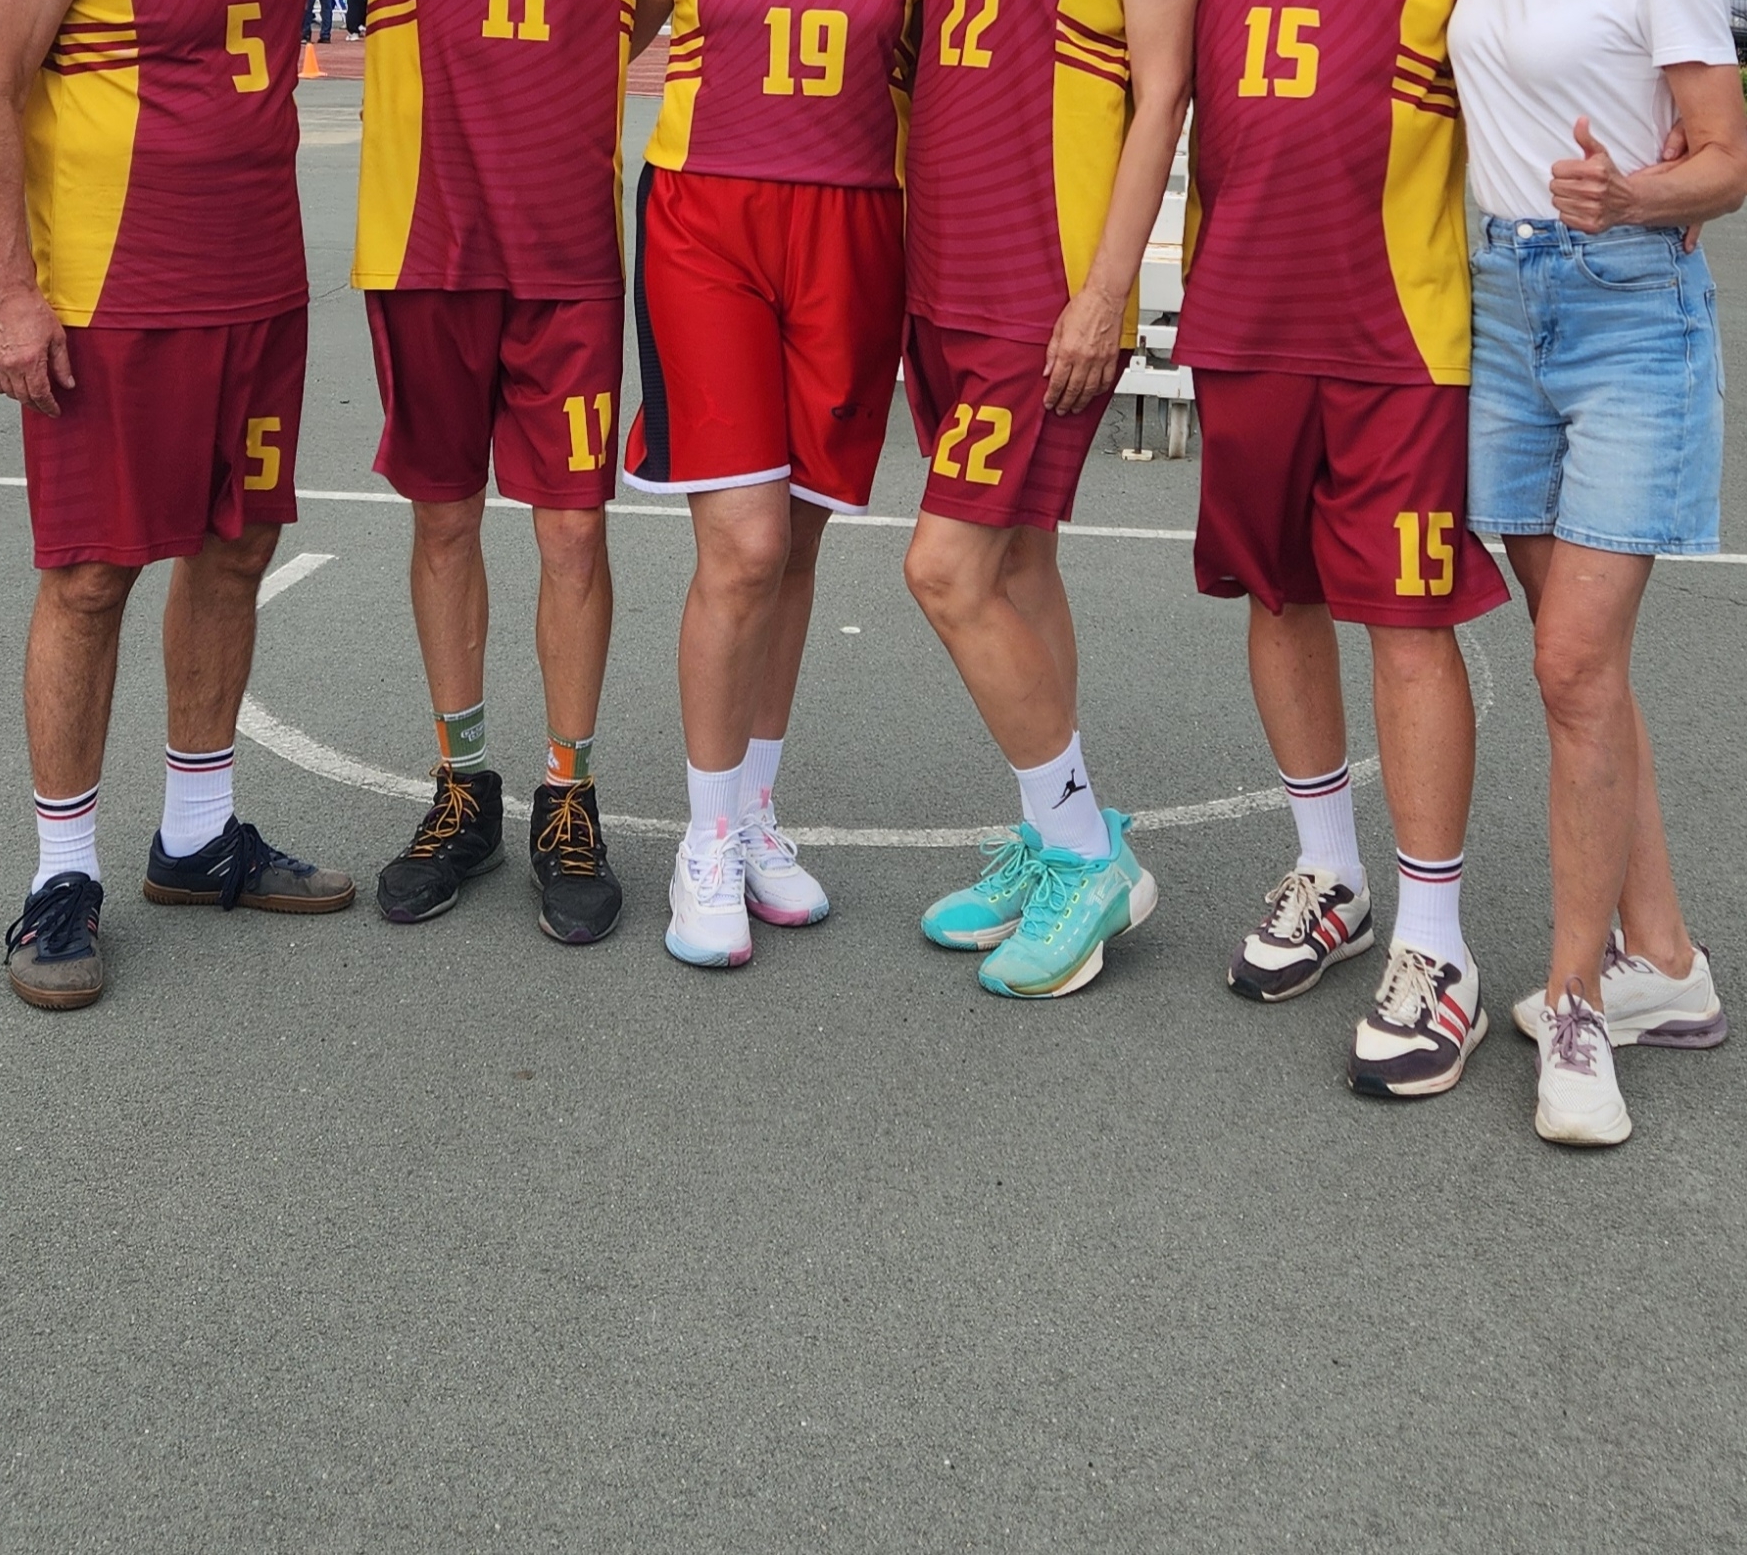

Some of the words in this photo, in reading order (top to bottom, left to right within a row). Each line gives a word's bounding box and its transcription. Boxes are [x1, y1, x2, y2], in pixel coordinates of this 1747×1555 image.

[225, 2, 270, 93] 5
[763, 7, 848, 97] 19
[1237, 7, 1320, 98] 15
[243, 416, 281, 491] 5
[933, 403, 1012, 485] 22
[1393, 511, 1455, 596] 15
